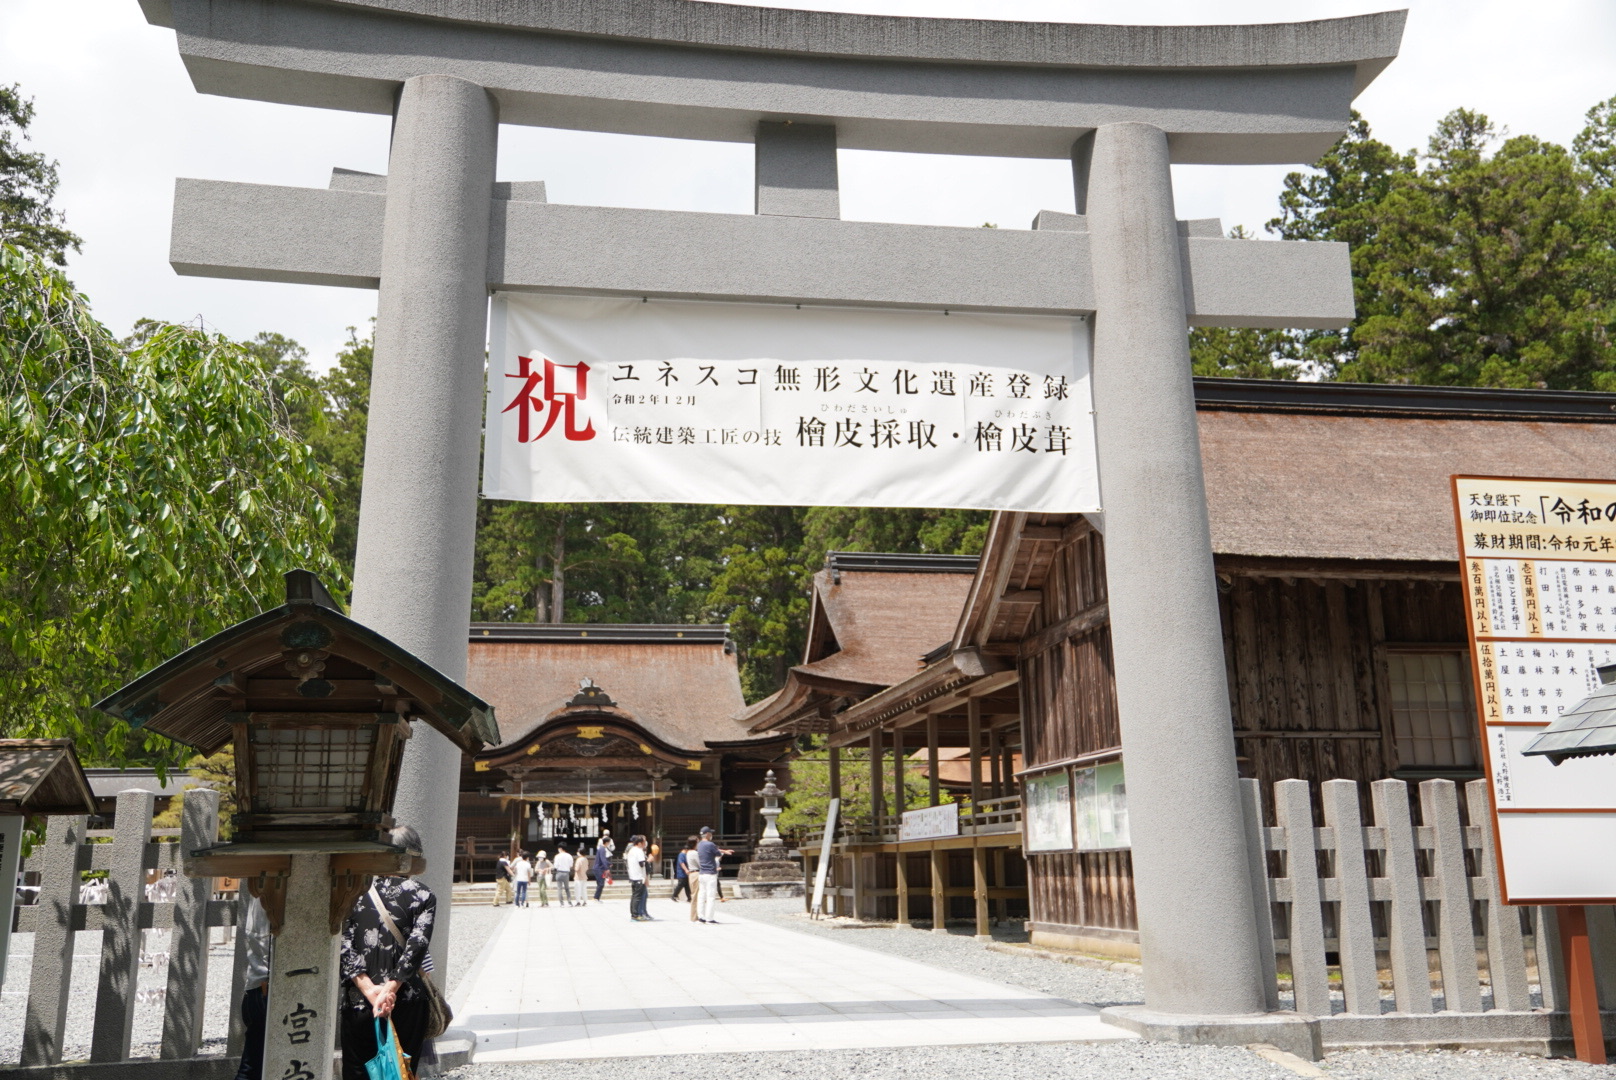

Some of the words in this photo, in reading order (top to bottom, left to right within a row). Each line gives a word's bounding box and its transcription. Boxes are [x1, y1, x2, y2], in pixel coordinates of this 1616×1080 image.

[612, 361, 1069, 401] ユネスコ無形文化遺産登録
[501, 356, 596, 443] 祝
[612, 426, 782, 446] 伝統建築工匠の技
[1469, 493, 1521, 507] 天皇陛下
[1470, 509, 1538, 524] 御即位記念
